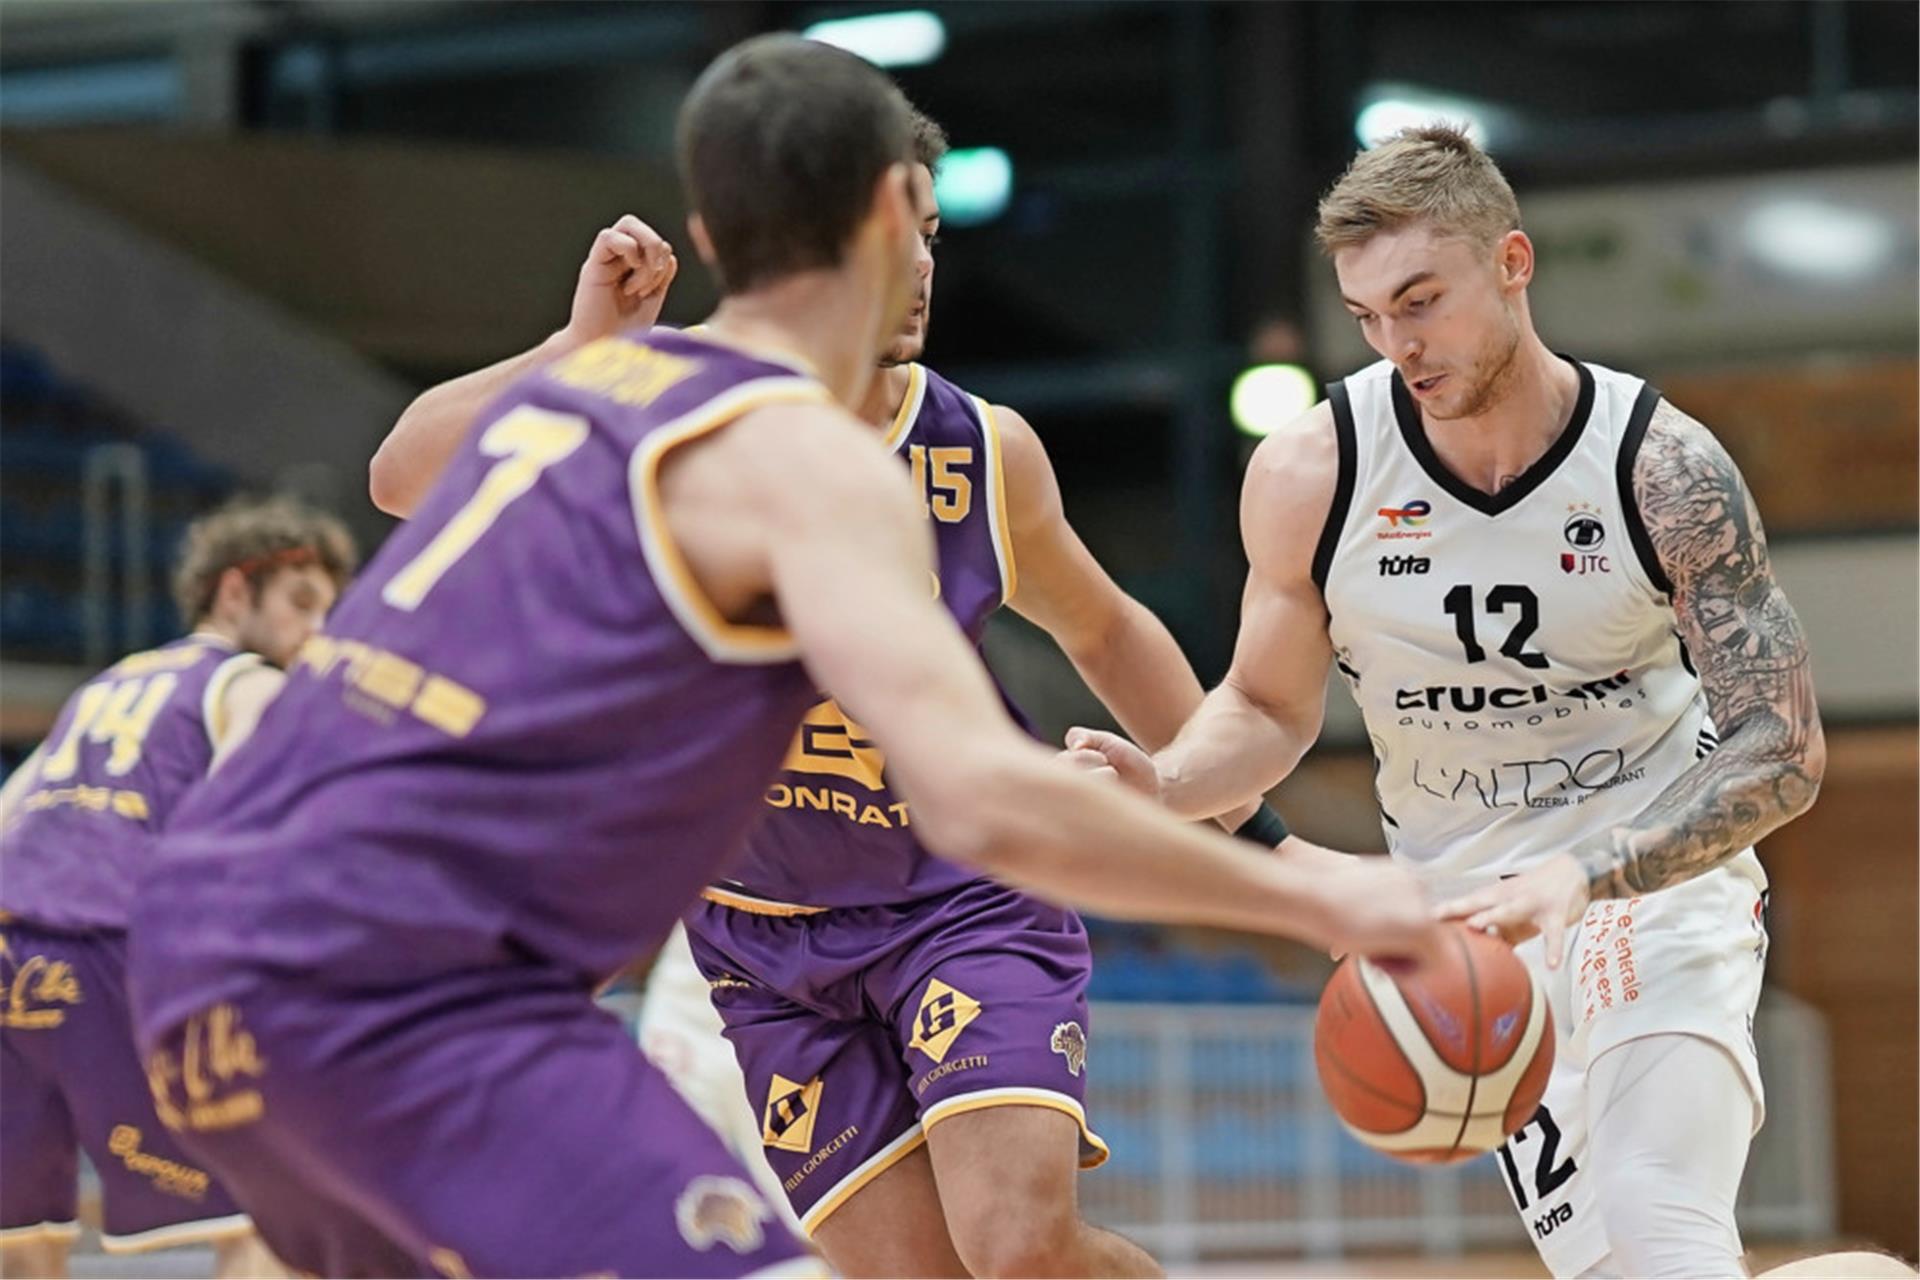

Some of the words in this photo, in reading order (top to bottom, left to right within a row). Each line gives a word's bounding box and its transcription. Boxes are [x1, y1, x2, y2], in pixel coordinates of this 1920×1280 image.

[381, 403, 593, 613] 7
[910, 444, 973, 523] 15
[1578, 555, 1611, 575] JTC
[1443, 584, 1550, 669] 12
[42, 672, 178, 781] 14
[764, 783, 910, 828] ONRAT
[928, 1055, 987, 1082] GIORGETTI
[802, 1125, 859, 1175] GIORGETTI
[1497, 1104, 1578, 1211] 12
